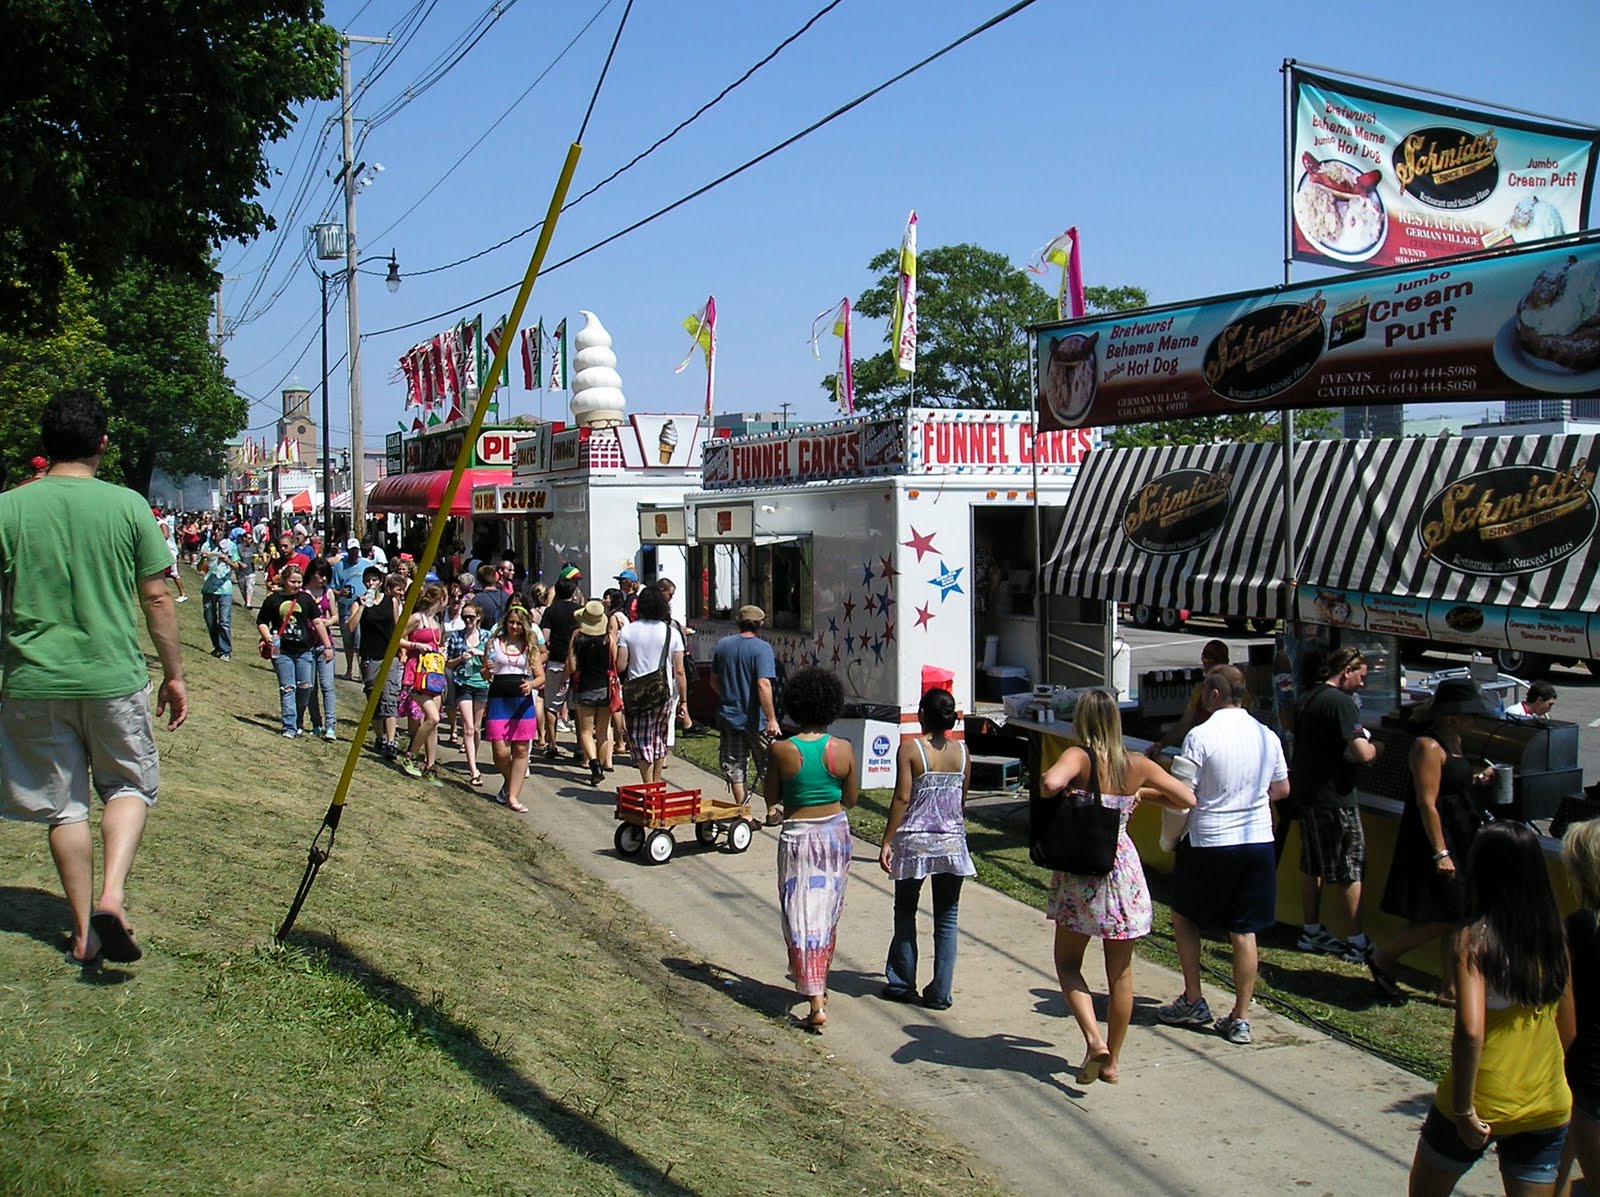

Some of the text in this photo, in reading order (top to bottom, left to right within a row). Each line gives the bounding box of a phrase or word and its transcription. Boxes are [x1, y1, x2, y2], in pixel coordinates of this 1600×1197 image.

[1325, 101, 1377, 124] Bratwurst
[1312, 114, 1386, 144] Bahama Mama
[1314, 136, 1381, 164] Jumbo Hot Dog
[1395, 128, 1498, 196] Schmidt's
[1527, 157, 1559, 169] Jumbo
[1508, 171, 1578, 187] Cream Puff
[1398, 209, 1484, 236] RESTAURANT
[1405, 227, 1480, 246] GERMAN VILLAGE
[1399, 247, 1427, 258] EVENTS
[1394, 271, 1451, 294] Jumbo
[1369, 281, 1474, 323] Cream
[1110, 316, 1175, 339] Bratwurst
[1384, 305, 1457, 348] Puff
[1106, 335, 1199, 360] Bahama Mama
[1104, 356, 1179, 382] Jumbo Hot Dog
[1320, 371, 1372, 385] EVENTS
[1390, 368, 1419, 381] (614)
[1317, 379, 1477, 398] CATERING (614) 444-5050
[923, 422, 1092, 464] FUNNEL CAKES
[732, 440, 791, 481] FUNNEL
[798, 432, 861, 476] CAKES
[502, 490, 547, 509] SLUSH
[1424, 456, 1595, 559] Schmidt's
[1488, 520, 1528, 538] SINCE
[1512, 551, 1549, 569] Sausage
[1549, 540, 1574, 559] Haus
